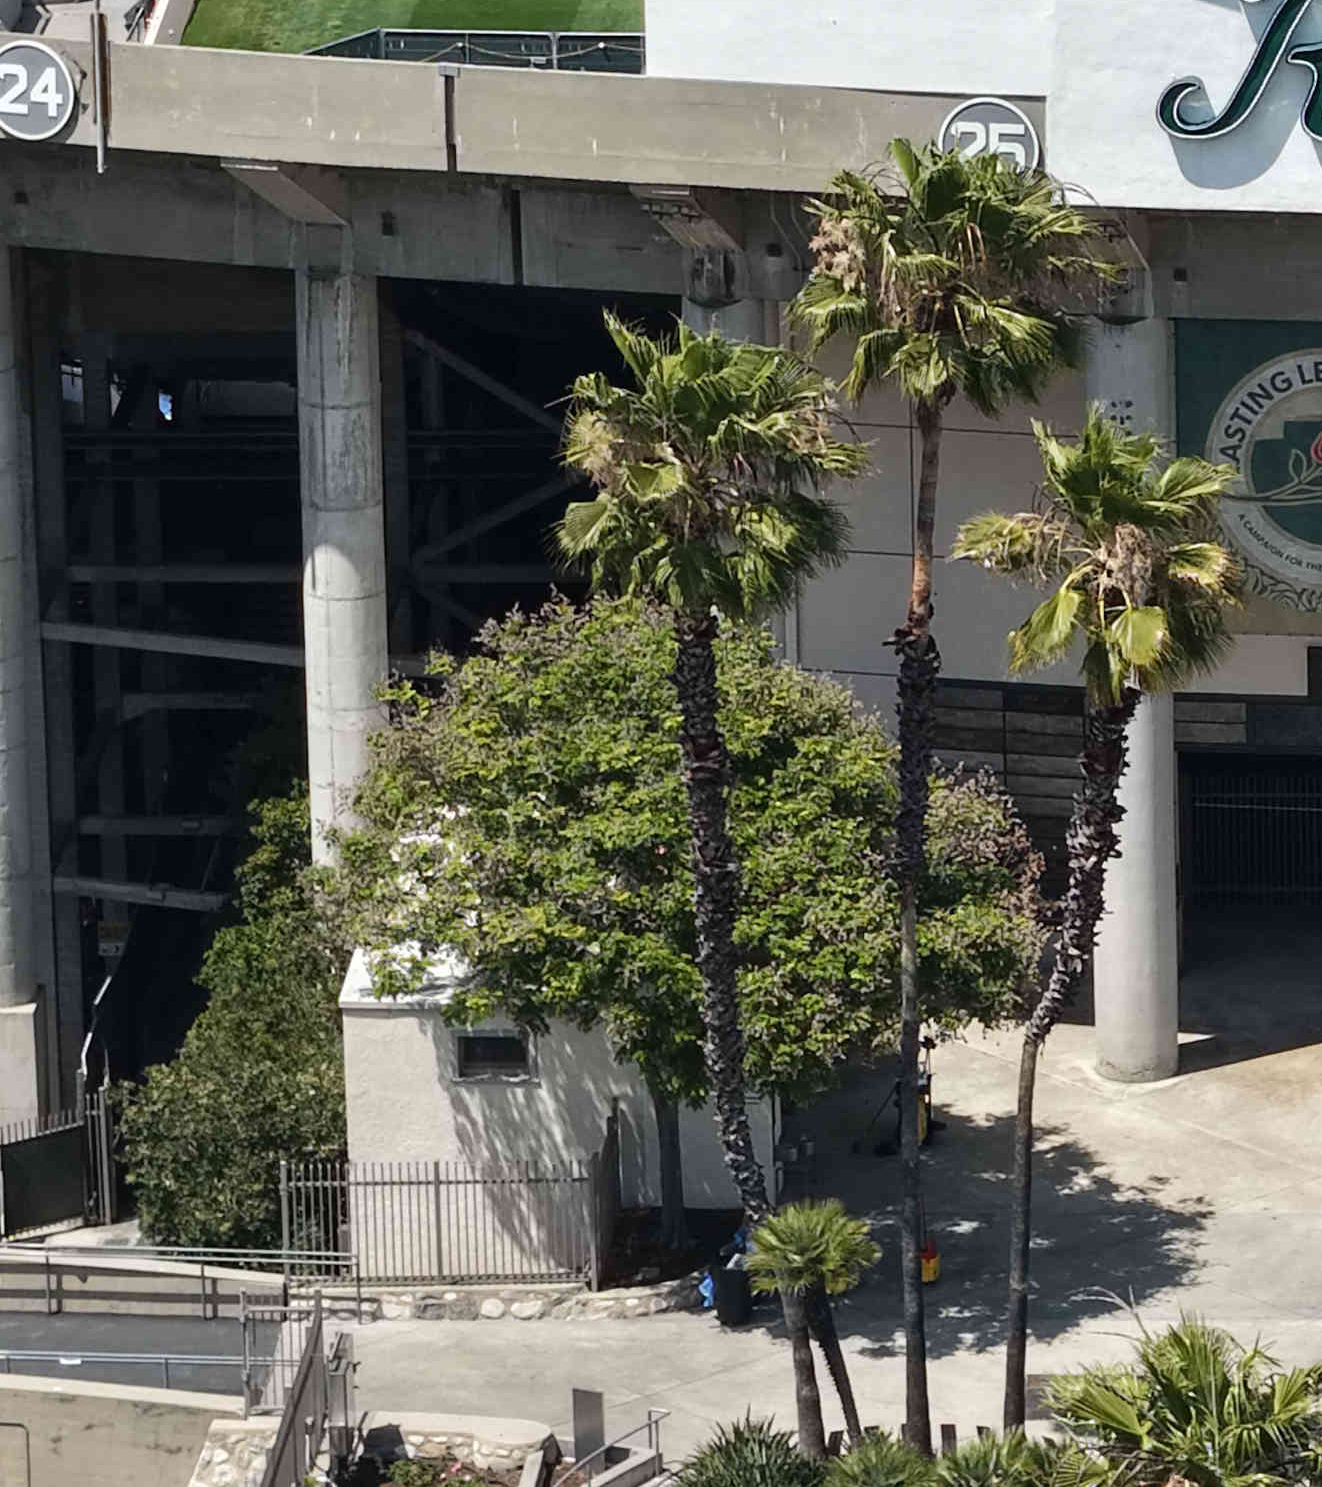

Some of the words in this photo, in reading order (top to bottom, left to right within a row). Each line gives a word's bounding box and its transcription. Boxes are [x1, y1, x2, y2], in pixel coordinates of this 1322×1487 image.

[0, 62, 64, 118] 24
[951, 120, 1026, 175] 25
[1219, 370, 1294, 474] ASTING
